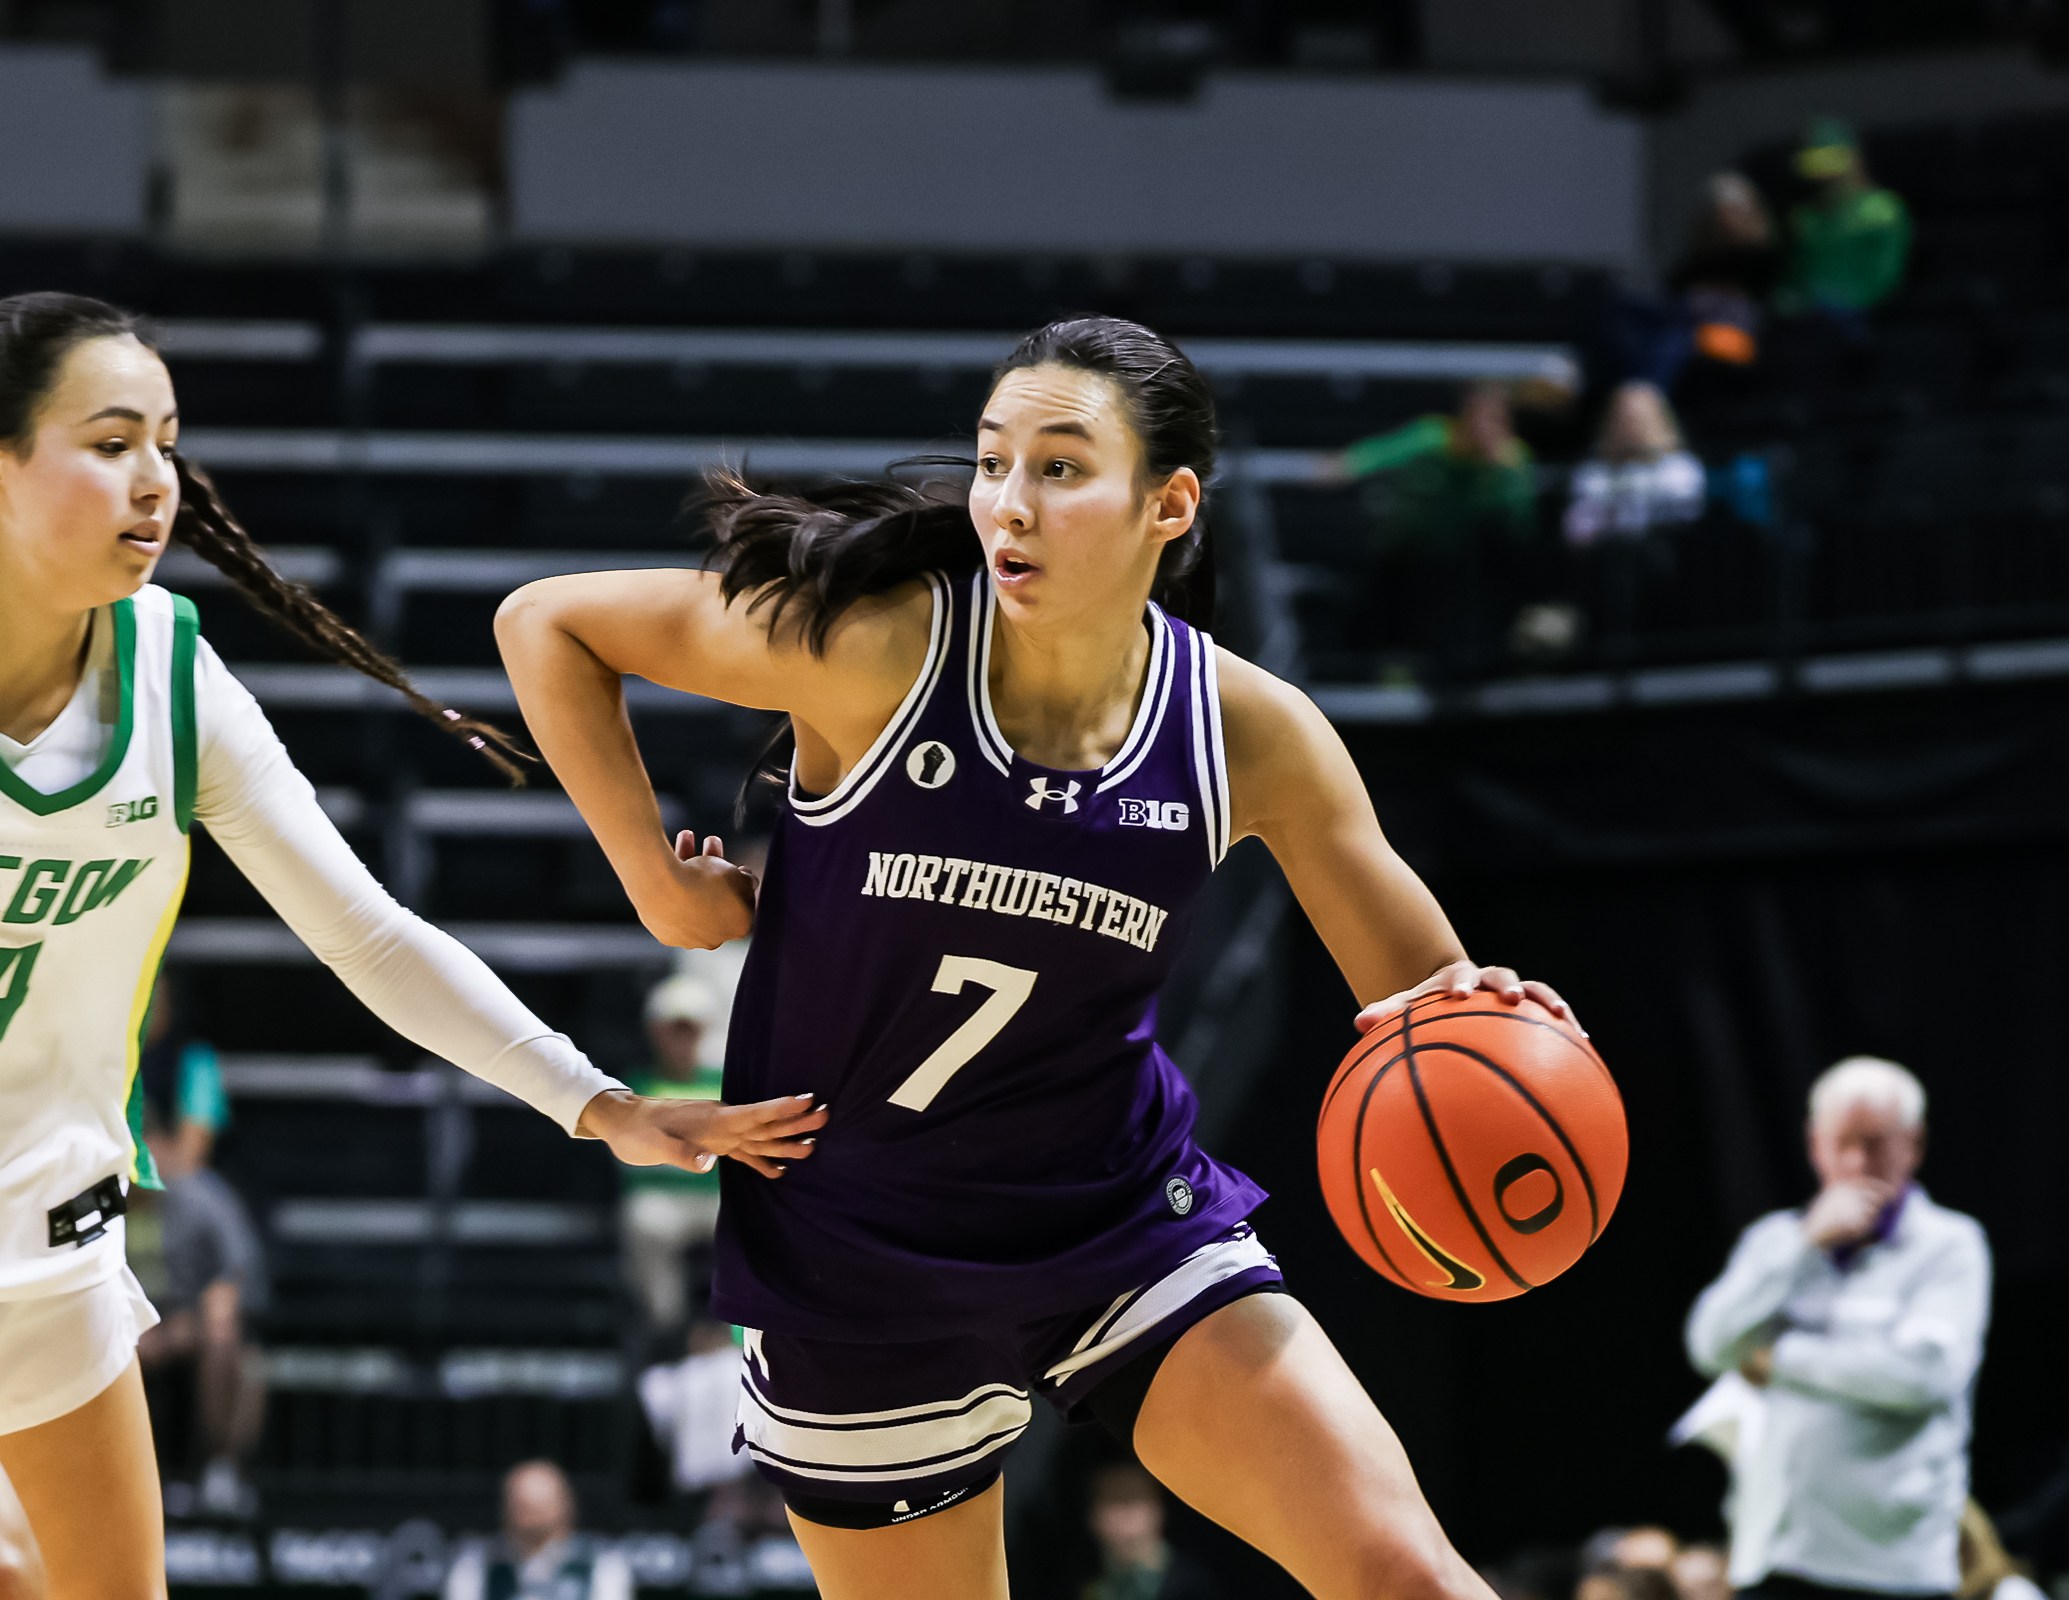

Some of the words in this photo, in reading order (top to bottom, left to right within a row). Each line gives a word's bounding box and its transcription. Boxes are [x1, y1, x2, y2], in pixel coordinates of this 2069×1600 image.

[0, 855, 154, 925] GON
[861, 852, 1168, 952] NORTHWESTERN
[887, 954, 1038, 1112] 7
[891, 1509, 927, 1523] UNDER
[929, 1487, 969, 1510] ARMOU
